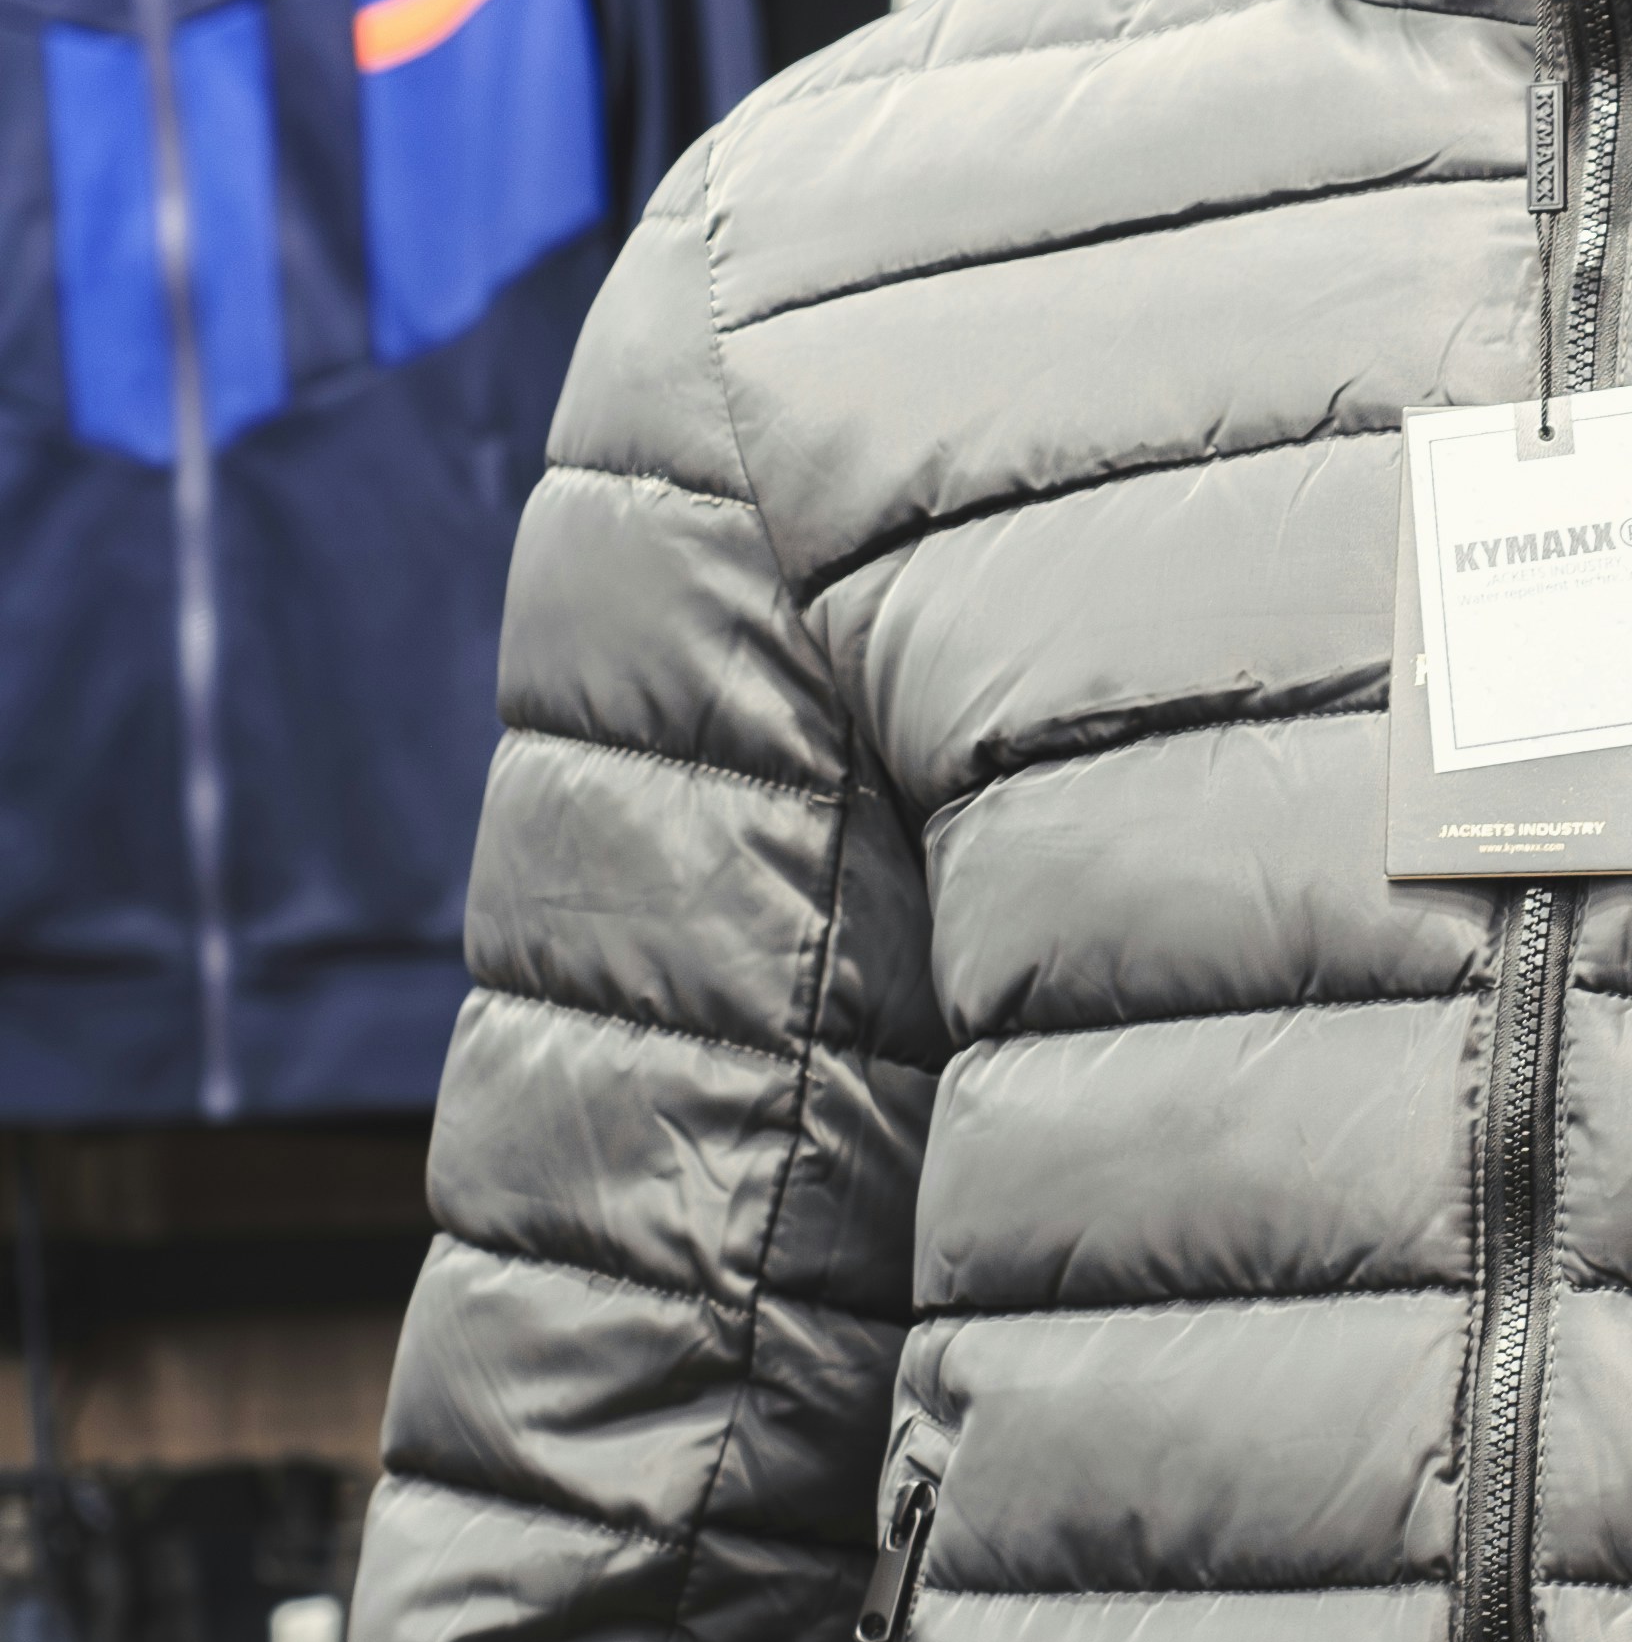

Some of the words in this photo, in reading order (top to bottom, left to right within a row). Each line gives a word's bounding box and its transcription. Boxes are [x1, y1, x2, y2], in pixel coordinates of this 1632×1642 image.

[1536, 88, 1555, 204] KYMAXX
[1438, 823, 1515, 838] JACKETS
[1518, 821, 1606, 836] INDUSTRY
[1479, 842, 1565, 854] www.kymaxx.com
